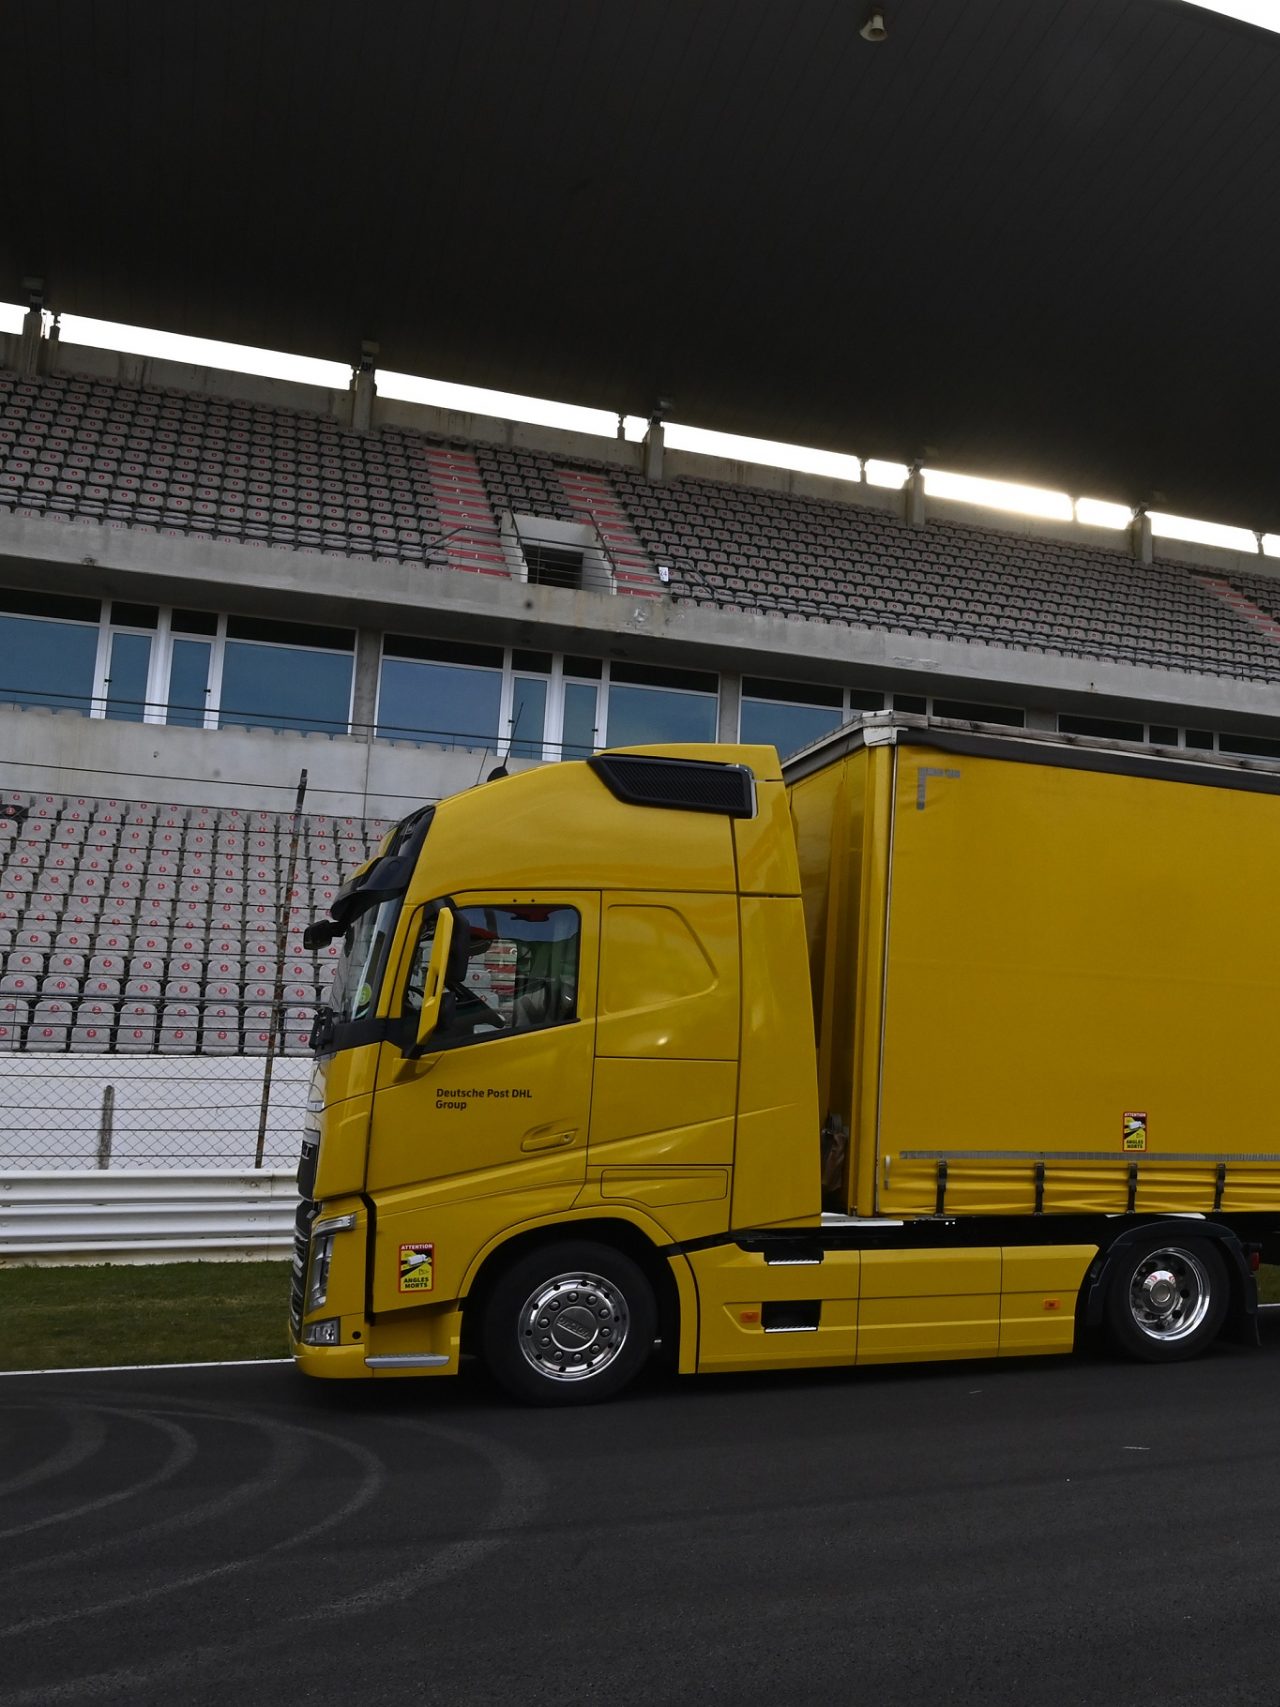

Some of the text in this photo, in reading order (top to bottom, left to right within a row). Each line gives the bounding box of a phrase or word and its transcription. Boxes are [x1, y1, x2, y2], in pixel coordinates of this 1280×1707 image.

[436, 1088, 532, 1098] Deutsche Post DHL
[436, 1100, 467, 1111] Group
